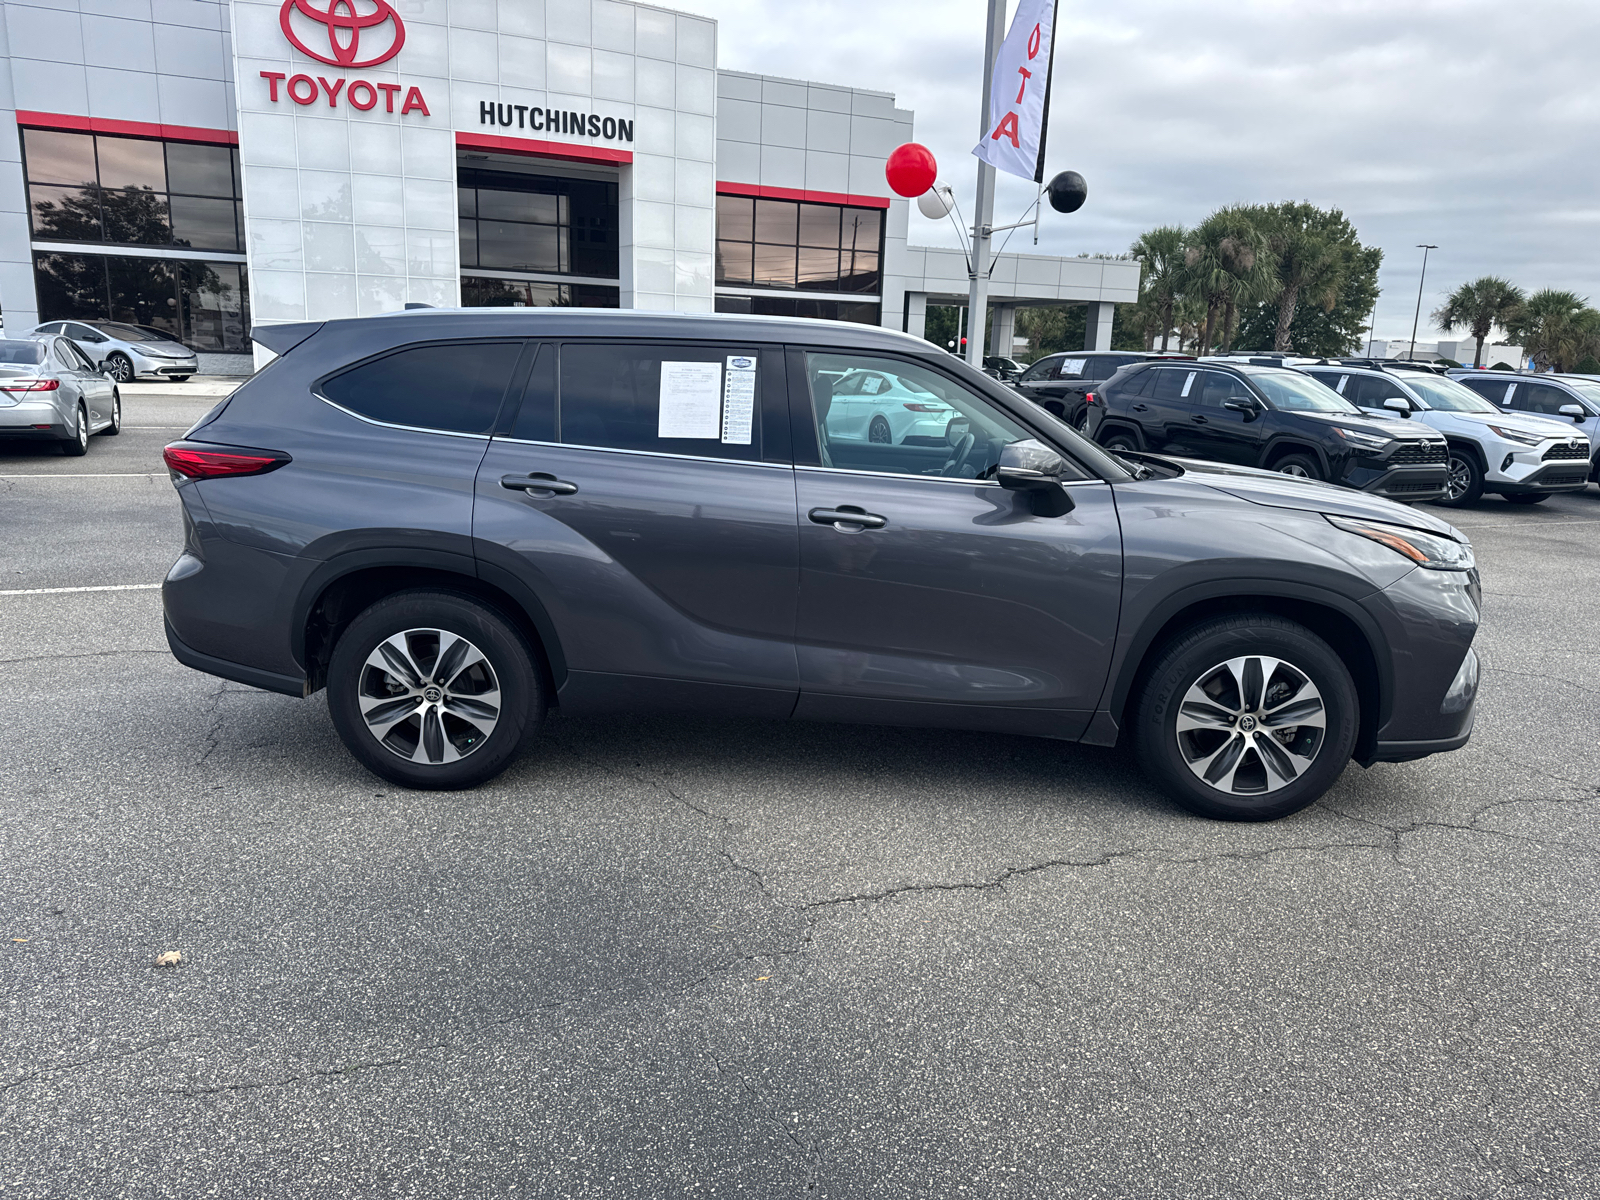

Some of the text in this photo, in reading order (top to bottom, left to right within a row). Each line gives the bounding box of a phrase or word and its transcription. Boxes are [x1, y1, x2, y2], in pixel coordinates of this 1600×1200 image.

[259, 70, 431, 117] TOYOTA
[480, 101, 634, 142] HUTCHINSON
[1152, 656, 1195, 727] FORTUNE
